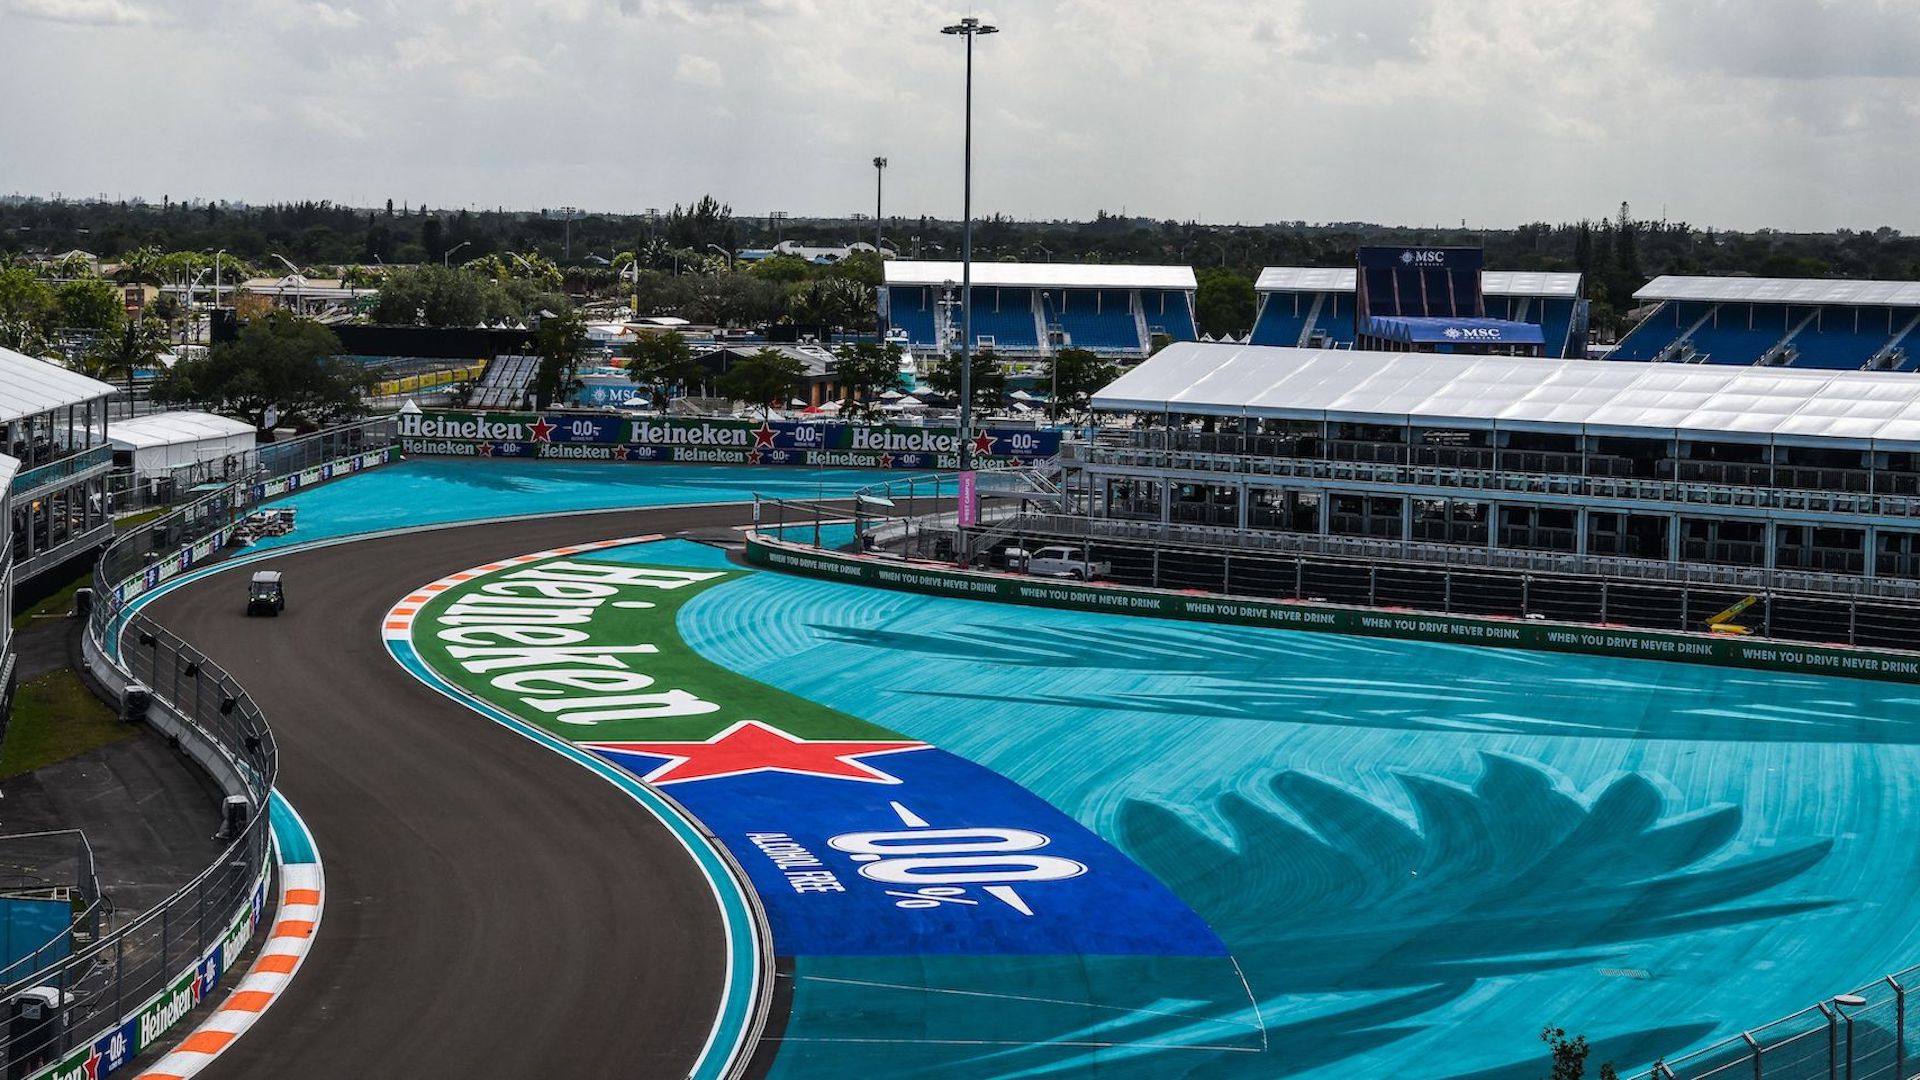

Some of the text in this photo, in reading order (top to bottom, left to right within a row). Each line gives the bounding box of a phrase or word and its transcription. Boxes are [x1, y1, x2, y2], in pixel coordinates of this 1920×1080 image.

[1415, 251, 1444, 262] MSC
[1462, 328, 1500, 337] MSC
[402, 413, 524, 440] Heineken
[630, 421, 747, 446] Heineken
[402, 439, 475, 455] Heineken
[539, 443, 610, 459] Heineken
[673, 446, 744, 462] Heineken
[806, 451, 876, 466] Heineken
[937, 453, 1004, 469] Heieken
[769, 553, 862, 577] WHEN YOU DRIVE NEVER DRINK
[879, 571, 997, 593] WHEN YOU DRIVE NEVER DRINK
[1020, 587, 1160, 609] WHEN YOU DRIVE NEVER DRINK
[1186, 602, 1335, 624] WHEN YOU DRIVE NEVER DRINK
[1362, 617, 1520, 640] WHEN YOU DRIVE NEVER DRINK
[437, 561, 728, 725] Heineken
[1548, 632, 1713, 656] WHEN YOU DRIVE NEVER DRINK
[1742, 649, 1919, 674] WHEN YOU DRIVE NEVER DRINK
[746, 832, 846, 893] ALCOHOL FREE
[140, 986, 191, 1049] Heineken
